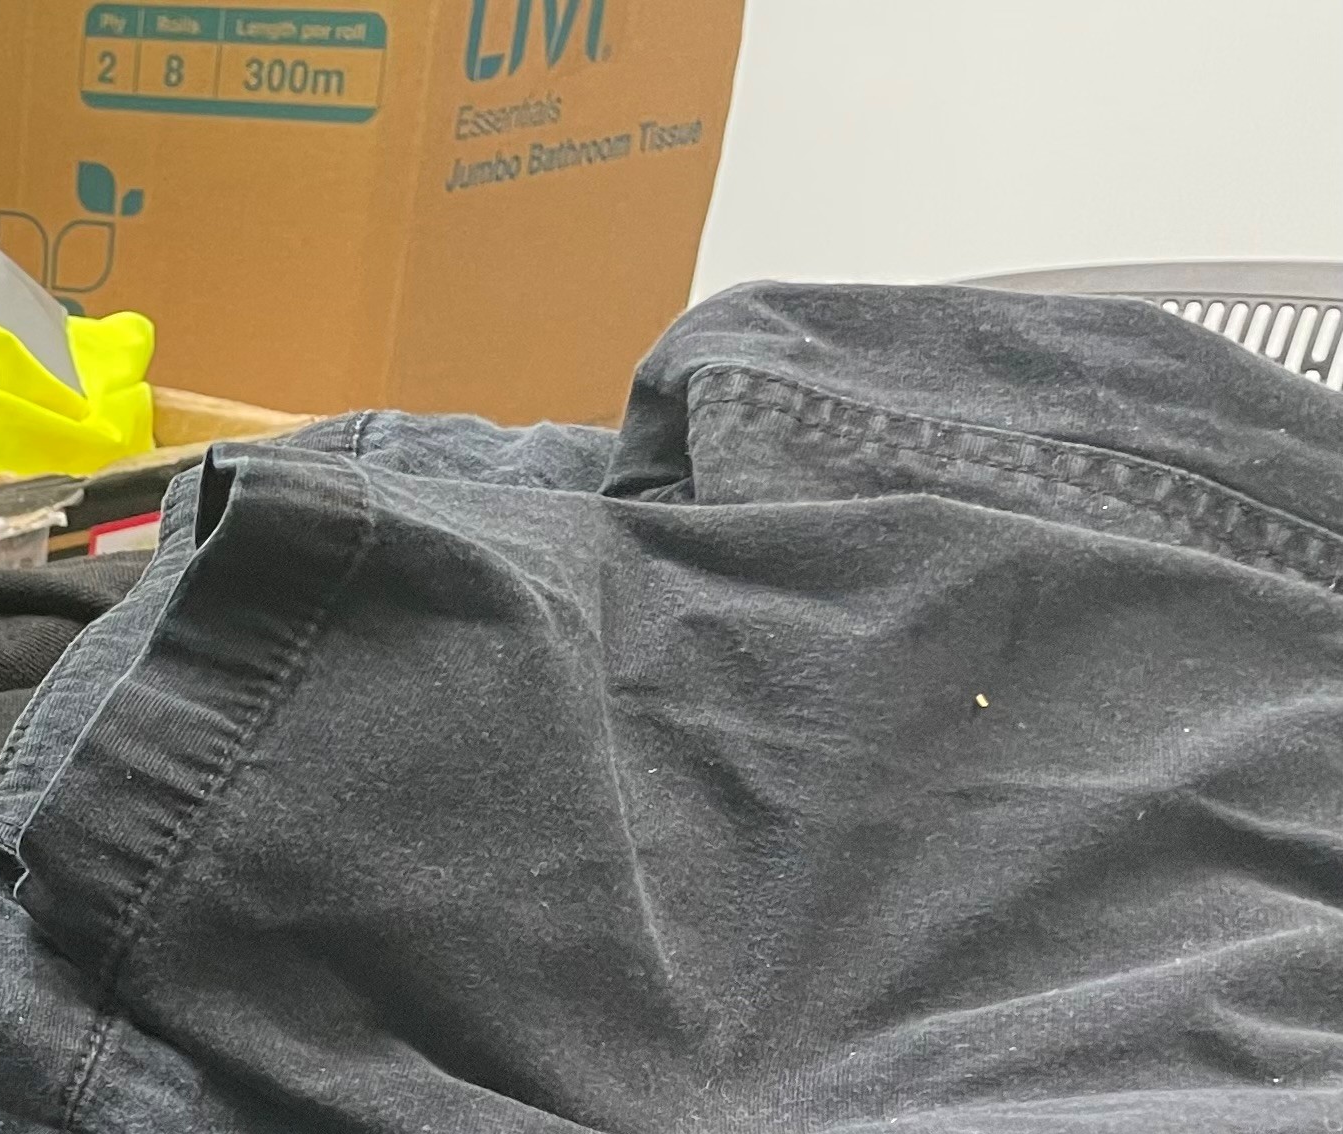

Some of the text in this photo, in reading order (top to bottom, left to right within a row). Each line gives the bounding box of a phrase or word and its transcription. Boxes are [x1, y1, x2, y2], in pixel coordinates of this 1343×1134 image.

[156, 15, 201, 34] Rolls
[235, 19, 366, 41] Length per roll
[97, 51, 117, 84] 2
[165, 54, 184, 87] 8
[244, 57, 345, 96] 300m
[455, 91, 562, 141] Essentials
[445, 119, 702, 192] Jumbo Bathroom Tissue
